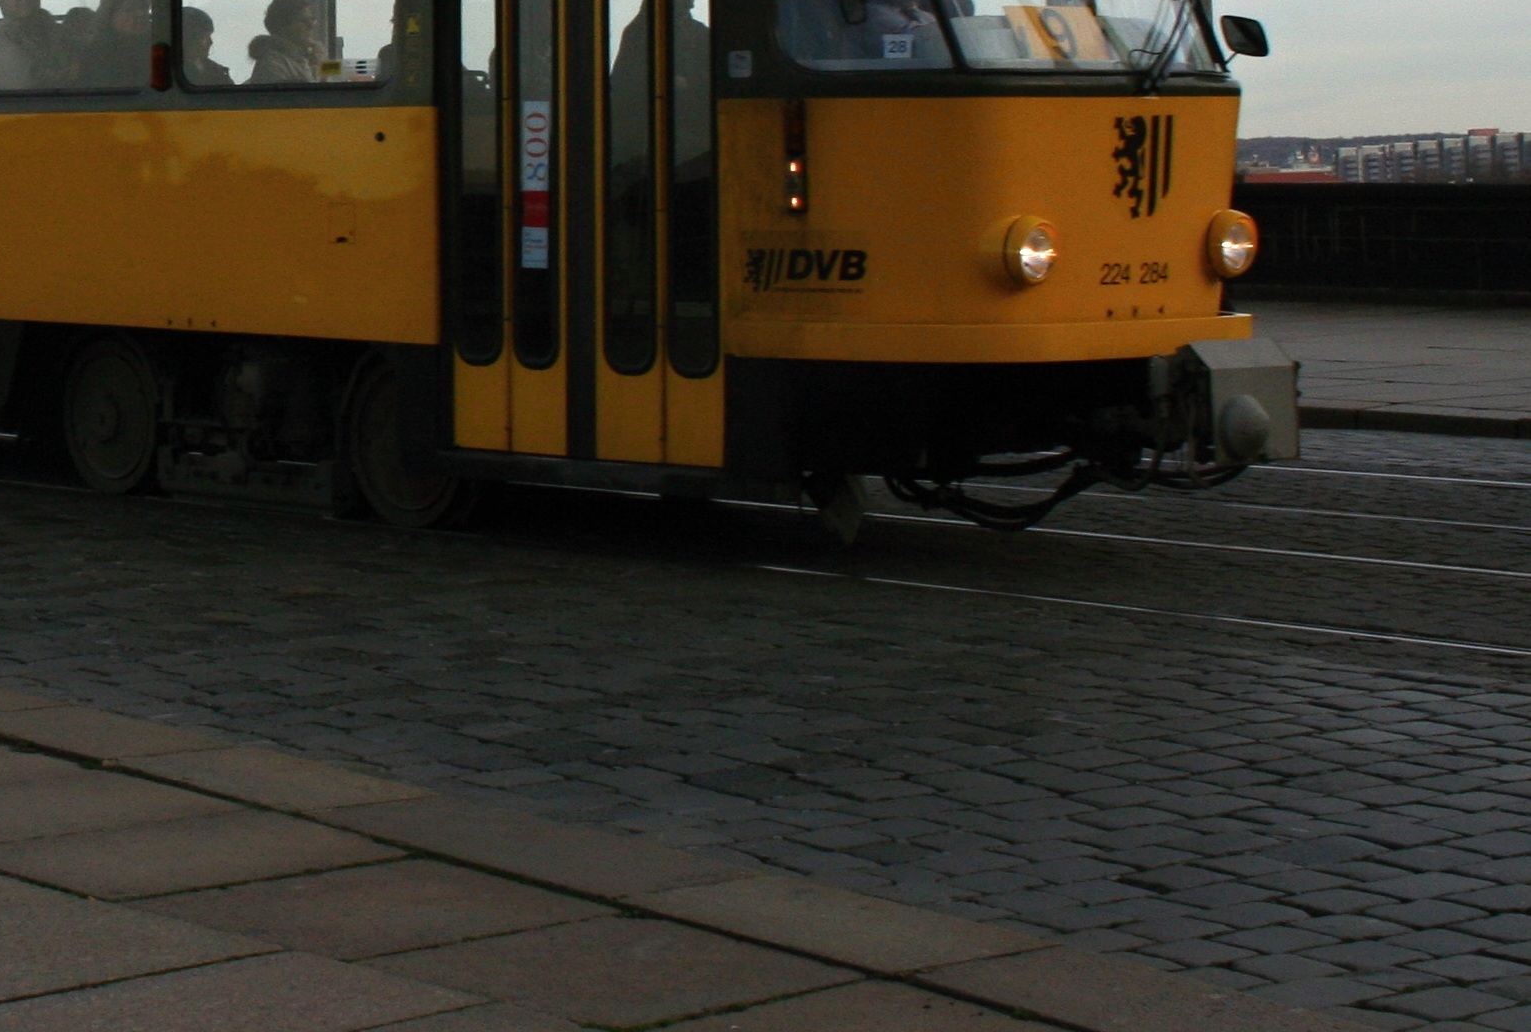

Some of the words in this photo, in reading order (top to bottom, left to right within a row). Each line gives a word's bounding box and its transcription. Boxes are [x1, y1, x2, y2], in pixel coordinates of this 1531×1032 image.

[887, 40, 907, 54] 28
[524, 112, 549, 181] 800
[786, 249, 867, 281] DVB
[1099, 263, 1131, 285] 224
[1139, 262, 1168, 284] 284
